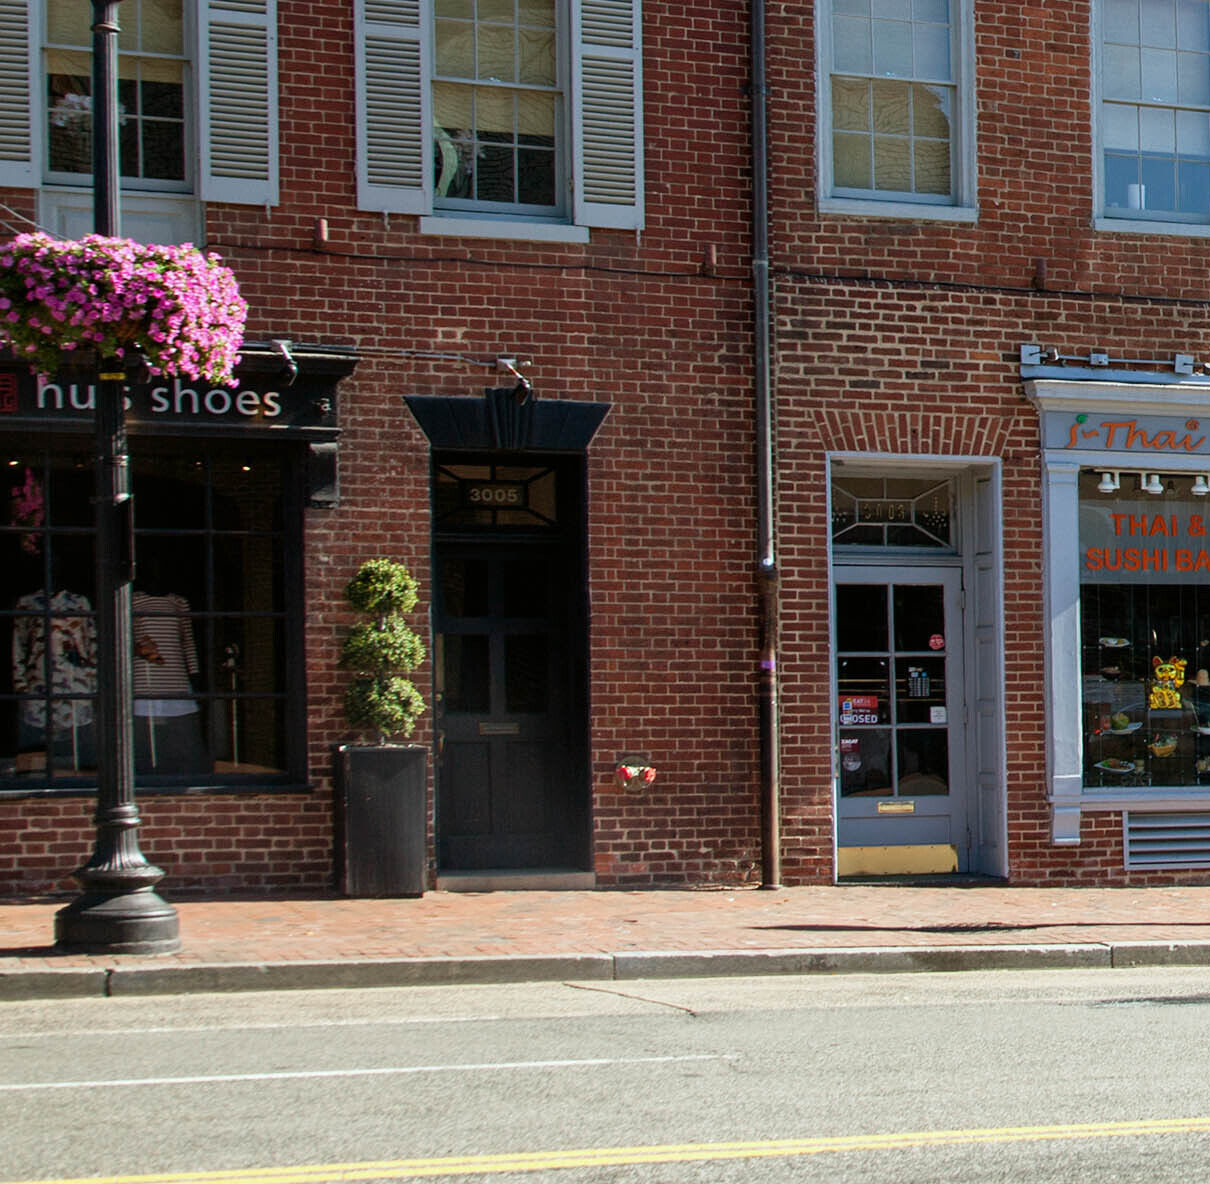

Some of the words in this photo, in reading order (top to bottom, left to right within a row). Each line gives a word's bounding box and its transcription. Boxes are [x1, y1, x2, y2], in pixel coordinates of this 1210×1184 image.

[151, 378, 282, 416] shoes
[470, 488, 518, 502] 3005
[1109, 514, 1179, 537] THAI
[1188, 514, 1208, 537] &
[1085, 547, 1169, 572] SUSHI
[840, 714, 878, 724] COSED
